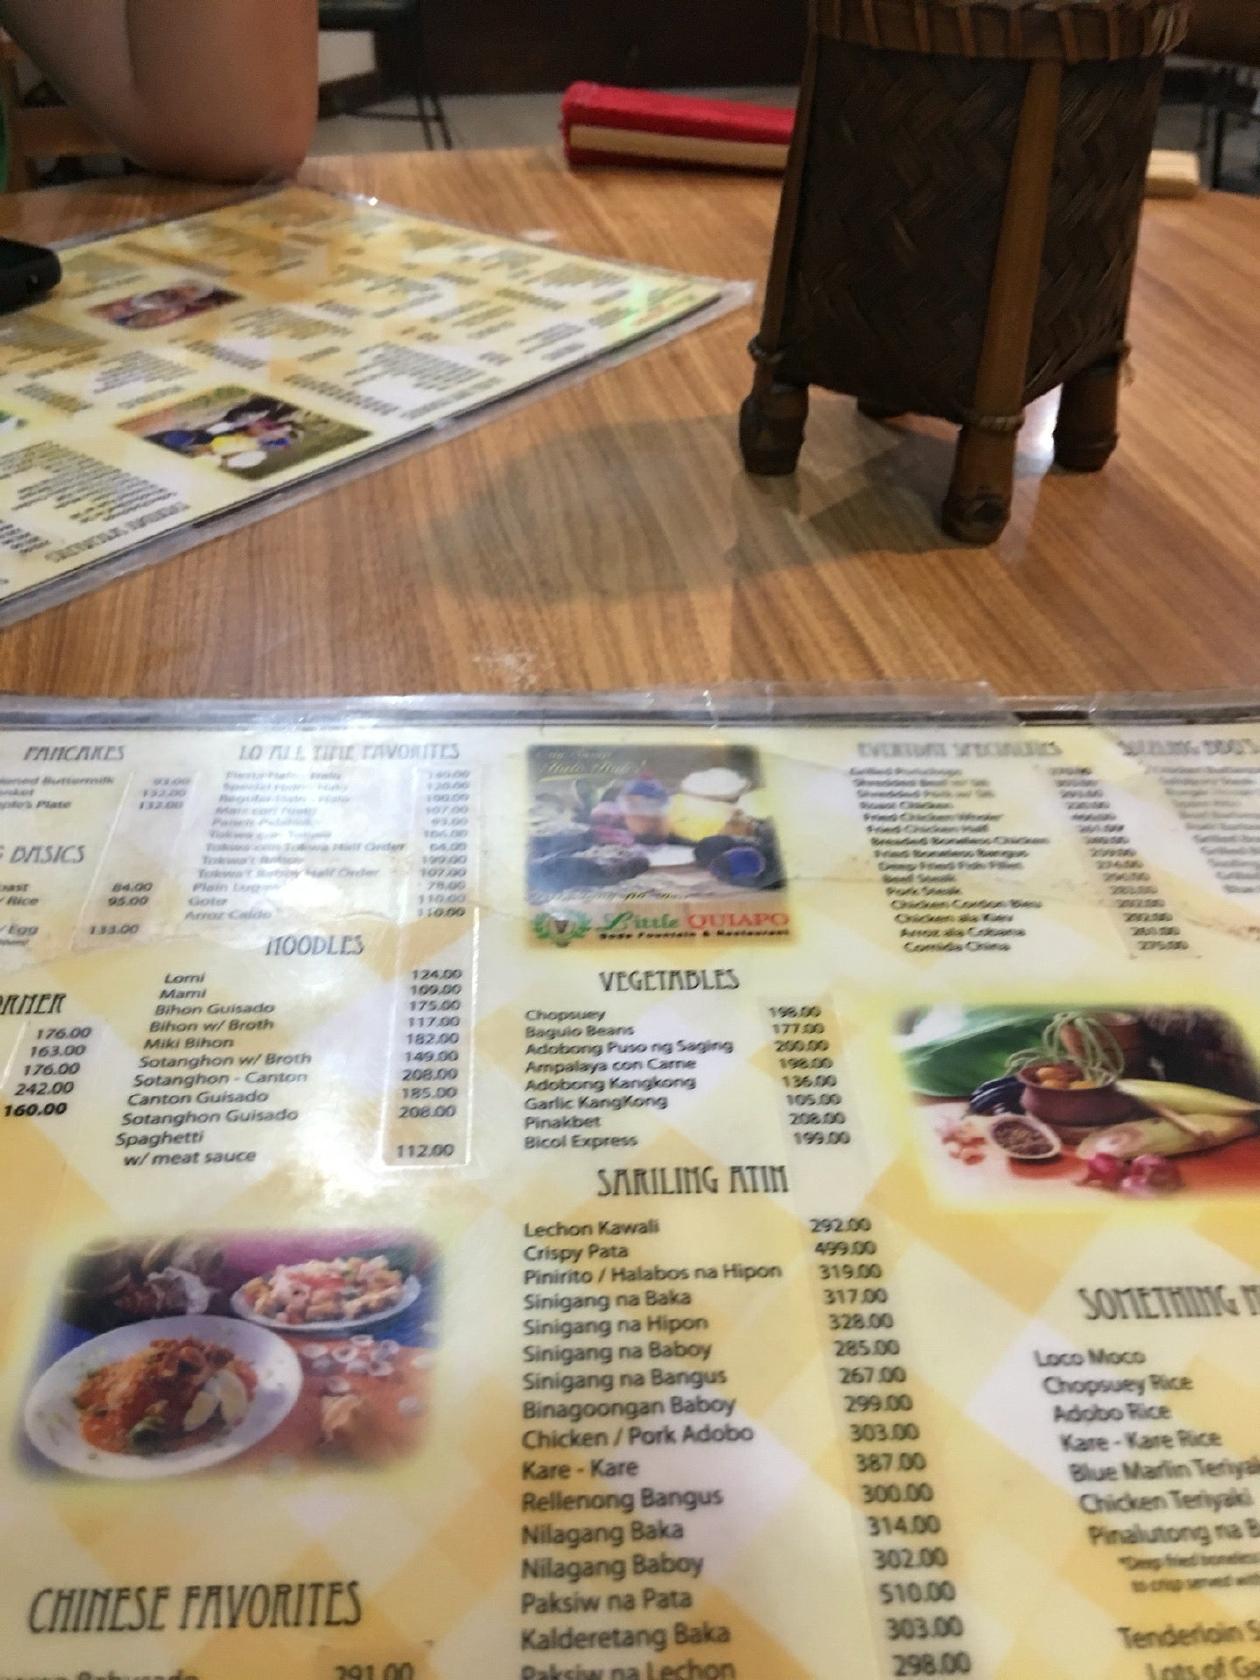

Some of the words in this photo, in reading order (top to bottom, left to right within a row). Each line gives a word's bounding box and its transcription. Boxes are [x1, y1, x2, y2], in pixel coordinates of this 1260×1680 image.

[23, 746, 126, 761] PANCAKES
[10, 845, 86, 863] BASICS
[687, 912, 790, 930] QUIAPO
[8, 926, 39, 935] Egg
[265, 935, 365, 956] NOODLES
[164, 973, 205, 984] Lomi
[412, 969, 462, 980] 124.00
[599, 969, 740, 992] VEGETABLES
[159, 989, 206, 999] Mami
[155, 1004, 203, 1016] Bihon
[207, 1003, 275, 1014] Guisado
[410, 1000, 461, 1011] 175.00
[408, 1016, 460, 1027] 117.00
[525, 1009, 606, 1022] Chopsuey
[37, 1027, 92, 1039] 176.00
[149, 1021, 198, 1033] Bihon
[203, 1020, 225, 1032] w/
[228, 1019, 274, 1031] Broth
[525, 1026, 583, 1040] Baguio
[586, 1025, 634, 1037] Beans
[772, 1023, 824, 1034] 177.00
[144, 1039, 182, 1049] Miki
[185, 1037, 234, 1049] Bihon
[407, 1033, 459, 1044] 182.00
[30, 1045, 87, 1057] 163.00
[524, 1042, 603, 1057] Adobong
[607, 1040, 647, 1054] Puso
[651, 1043, 673, 1056] ng
[676, 1039, 734, 1055] Saging
[24, 1063, 80, 1076] 176.00
[138, 1056, 235, 1070] Sotanghon
[240, 1055, 262, 1066] w/
[266, 1053, 312, 1065] Broth
[524, 1059, 607, 1075] Ampalaya
[612, 1060, 644, 1072] con
[647, 1058, 696, 1070] Carne
[133, 1074, 229, 1088] Sotanghon
[245, 1072, 307, 1084] Canton
[402, 1069, 458, 1081] 208.00
[782, 1075, 837, 1088] 136.00
[15, 1081, 74, 1096] 242.00
[402, 1087, 457, 1099] 185.00
[524, 1078, 604, 1093] Adobong
[609, 1076, 697, 1091] Kangkong
[128, 1093, 192, 1106] Canton
[196, 1091, 269, 1103] Guisado
[524, 1097, 574, 1111] Garlic
[786, 1094, 842, 1106] 105.00
[4, 1102, 67, 1117] 160.00
[121, 1112, 220, 1127] Sotanghon
[225, 1109, 299, 1122] Guisado
[524, 1115, 602, 1130] Pinakbet
[115, 1131, 204, 1148] Spaghetti
[524, 1135, 567, 1149] Bicol
[571, 1133, 638, 1150] Express
[793, 1131, 850, 1145] 199.00
[124, 1153, 149, 1167] w/
[152, 1152, 200, 1165] meat
[206, 1151, 256, 1163] sauce
[396, 1144, 454, 1158] 112.00
[597, 1166, 719, 1197] SARILING
[729, 1165, 789, 1194] ATIN
[523, 1222, 593, 1237] Lechon
[599, 1219, 660, 1236] Kawali
[810, 1218, 871, 1233] 292.00
[523, 1246, 583, 1263] Crispy
[588, 1244, 628, 1259] Pata
[814, 1241, 877, 1256] 499.00
[523, 1269, 592, 1285] Pinirito
[611, 1266, 689, 1283] Halabos
[695, 1268, 718, 1280] na
[723, 1264, 782, 1282] Hipon
[819, 1264, 882, 1279] 319.00
[523, 1294, 610, 1313] Sinigang
[615, 1295, 641, 1307] na
[645, 1291, 691, 1306] Baka
[823, 1288, 888, 1304] 317.00
[1077, 1284, 1240, 1321] SOMETHING
[523, 1319, 611, 1339] Sinigang
[616, 1321, 642, 1333] na
[647, 1316, 708, 1334] Hipon
[829, 1314, 893, 1329] 328.00
[523, 1345, 612, 1364] Sinigang
[618, 1347, 644, 1360] na
[649, 1342, 711, 1362] Baboy
[834, 1340, 900, 1356] 285.00
[1034, 1349, 1084, 1367] Loco
[1088, 1348, 1147, 1365] Moco
[523, 1372, 614, 1393] Sinigang
[619, 1374, 645, 1388] na
[651, 1369, 727, 1389] Bangus
[839, 1367, 906, 1384] 267.00
[1042, 1376, 1146, 1396] Chopsuey
[1149, 1374, 1194, 1390] Rice
[523, 1400, 666, 1422] Binagoongan
[670, 1396, 736, 1417] Baboy
[845, 1395, 913, 1412] 299.00
[1053, 1404, 1124, 1423] Adobo
[1126, 1403, 1173, 1420] Rice
[522, 1430, 608, 1449] Chicken
[628, 1426, 676, 1445] Pork
[682, 1424, 754, 1443] Adobo
[850, 1422, 919, 1442] 303.00
[1061, 1434, 1110, 1452] Kare
[1124, 1432, 1174, 1450] Kare
[1176, 1429, 1223, 1447] Rice
[522, 1462, 571, 1480] Kare
[591, 1459, 639, 1478] Kare
[855, 1452, 926, 1473] 387.00
[1069, 1463, 1118, 1482] Blue
[1122, 1461, 1192, 1480] Marlin
[522, 1491, 634, 1515] Rellenong
[640, 1488, 724, 1512] Bangus
[861, 1483, 934, 1503] 300.00
[1079, 1493, 1169, 1514] Chicken
[1168, 1487, 1254, 1513] Teriyaki
[867, 1515, 940, 1536] 314.00
[1214, 1524, 1243, 1539] na
[521, 1524, 624, 1549] Nilagang
[631, 1521, 684, 1541] Baka
[874, 1547, 948, 1569] 302.00
[521, 1557, 626, 1581] Nilagang
[633, 1553, 703, 1578] Baboy
[879, 1581, 955, 1603] 510.00
[28, 1585, 170, 1635] CHINESE
[179, 1581, 363, 1630] FAVORITES
[521, 1593, 601, 1615] Paksiw
[607, 1596, 635, 1611] na
[642, 1588, 693, 1610] Pata
[886, 1617, 964, 1640] 303.00
[1117, 1624, 1245, 1649] Tenderloin
[520, 1626, 667, 1653] Kalderetang
[675, 1623, 730, 1644] Baka
[521, 1665, 604, 1680] Paksiw
[612, 1667, 640, 1680] na
[646, 1661, 735, 1680] Lechon
[892, 1653, 970, 1677] 298.00
